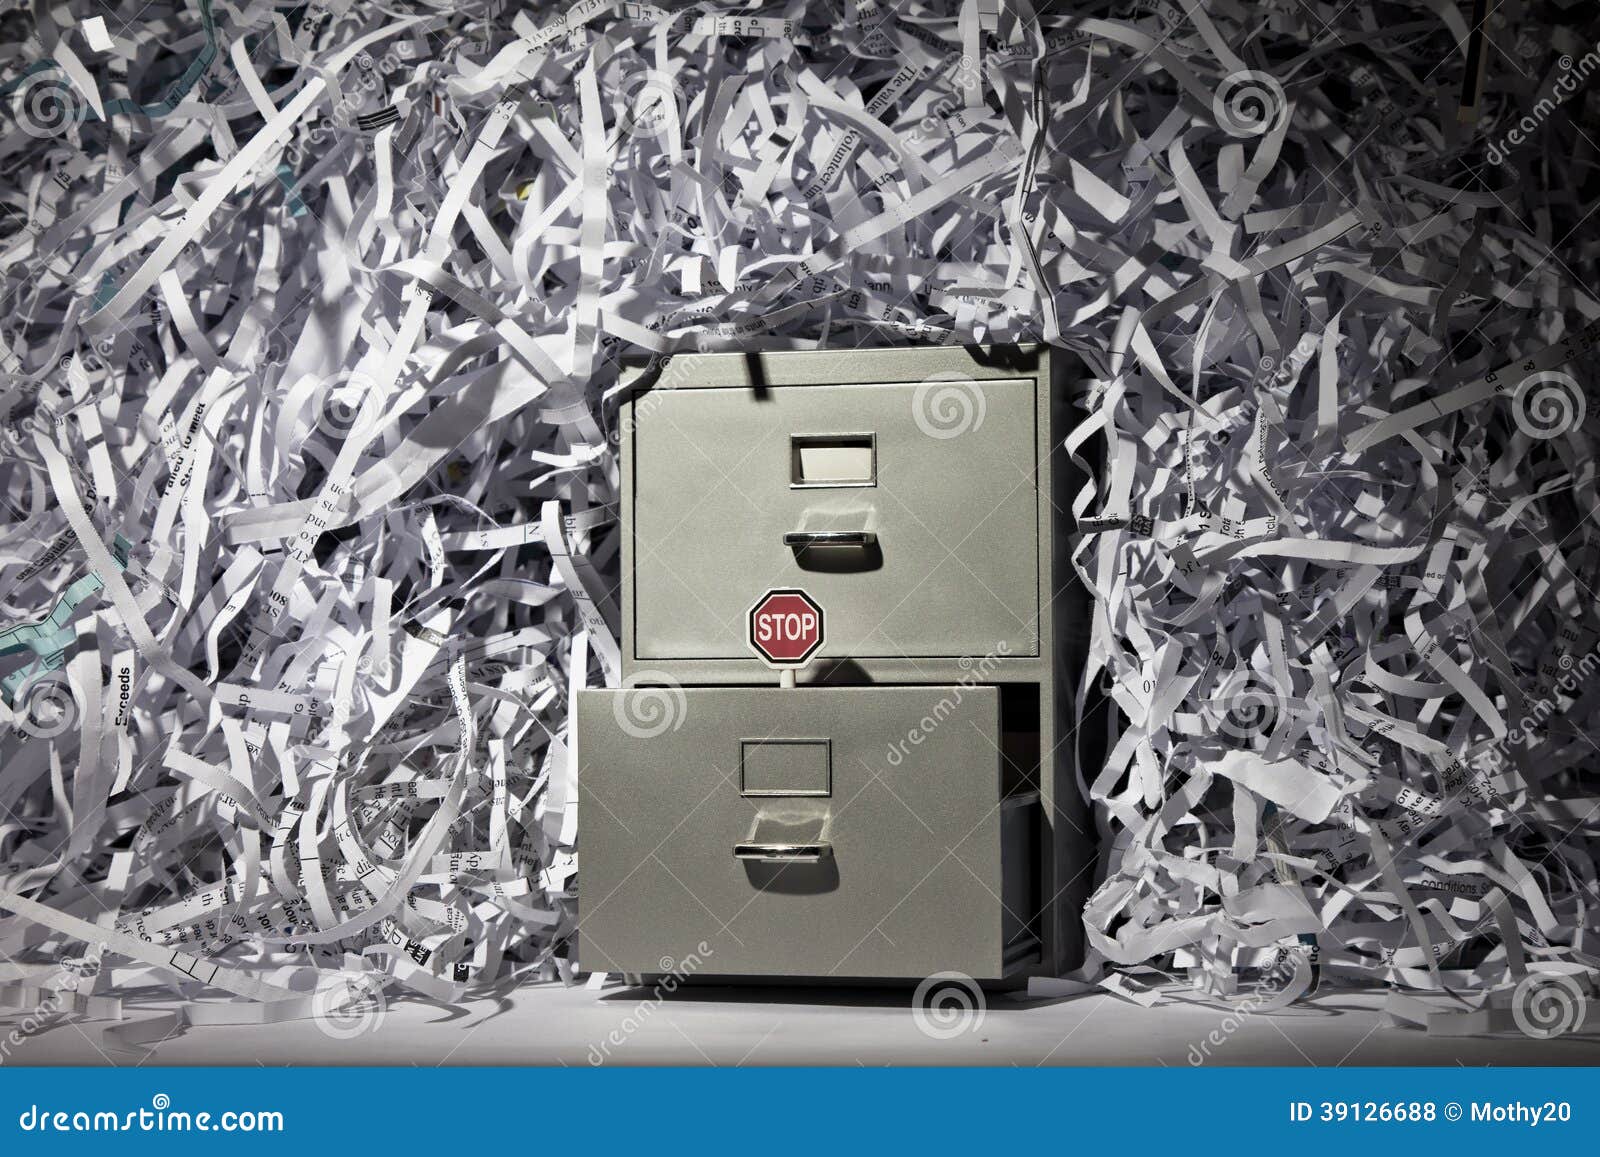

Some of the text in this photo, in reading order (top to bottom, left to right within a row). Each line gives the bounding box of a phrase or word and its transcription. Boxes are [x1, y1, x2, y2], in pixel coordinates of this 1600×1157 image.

[866, 65, 918, 115] The value
[819, 129, 859, 186] volunteer
[758, 612, 816, 641] STOP
